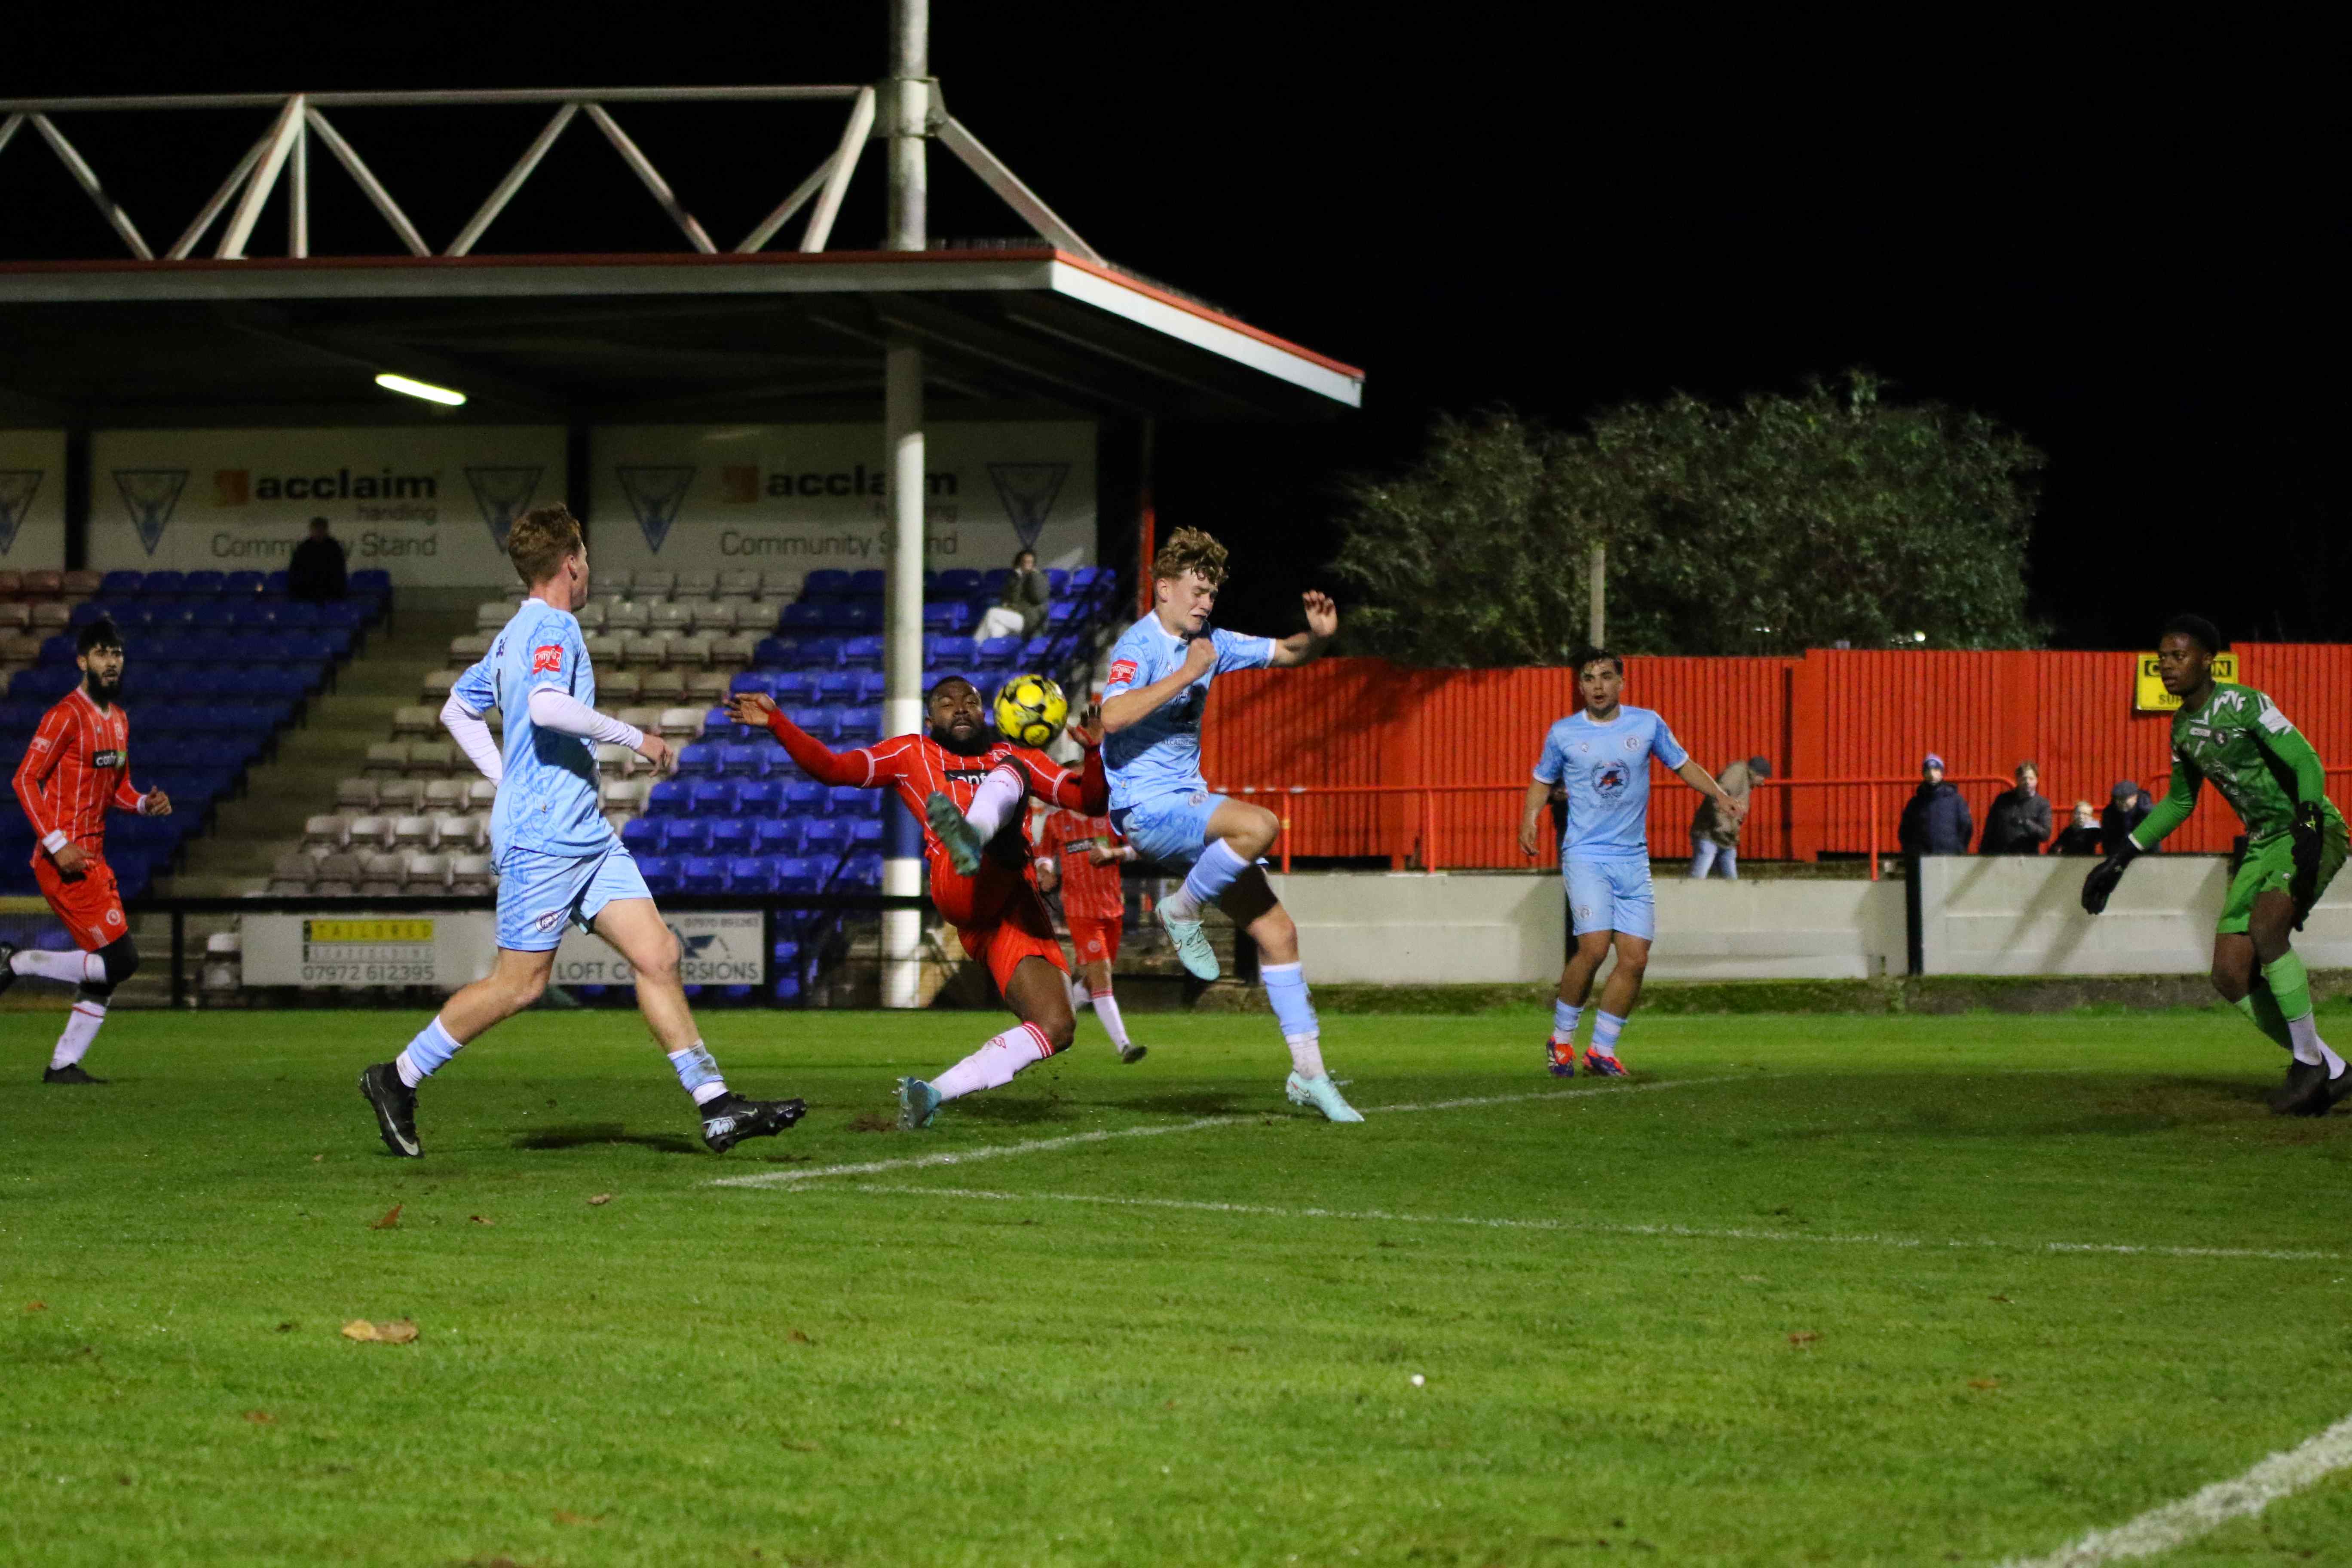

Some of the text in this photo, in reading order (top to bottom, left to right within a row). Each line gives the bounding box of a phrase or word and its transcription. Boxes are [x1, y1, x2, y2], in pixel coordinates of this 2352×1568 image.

[257, 469, 437, 499] acclaim
[767, 464, 957, 496] acclam
[211, 531, 437, 560] Commy Stand
[720, 530, 958, 557] Community Snd
[303, 965, 435, 980] 07972 612395
[557, 962, 606, 980] LOFT
